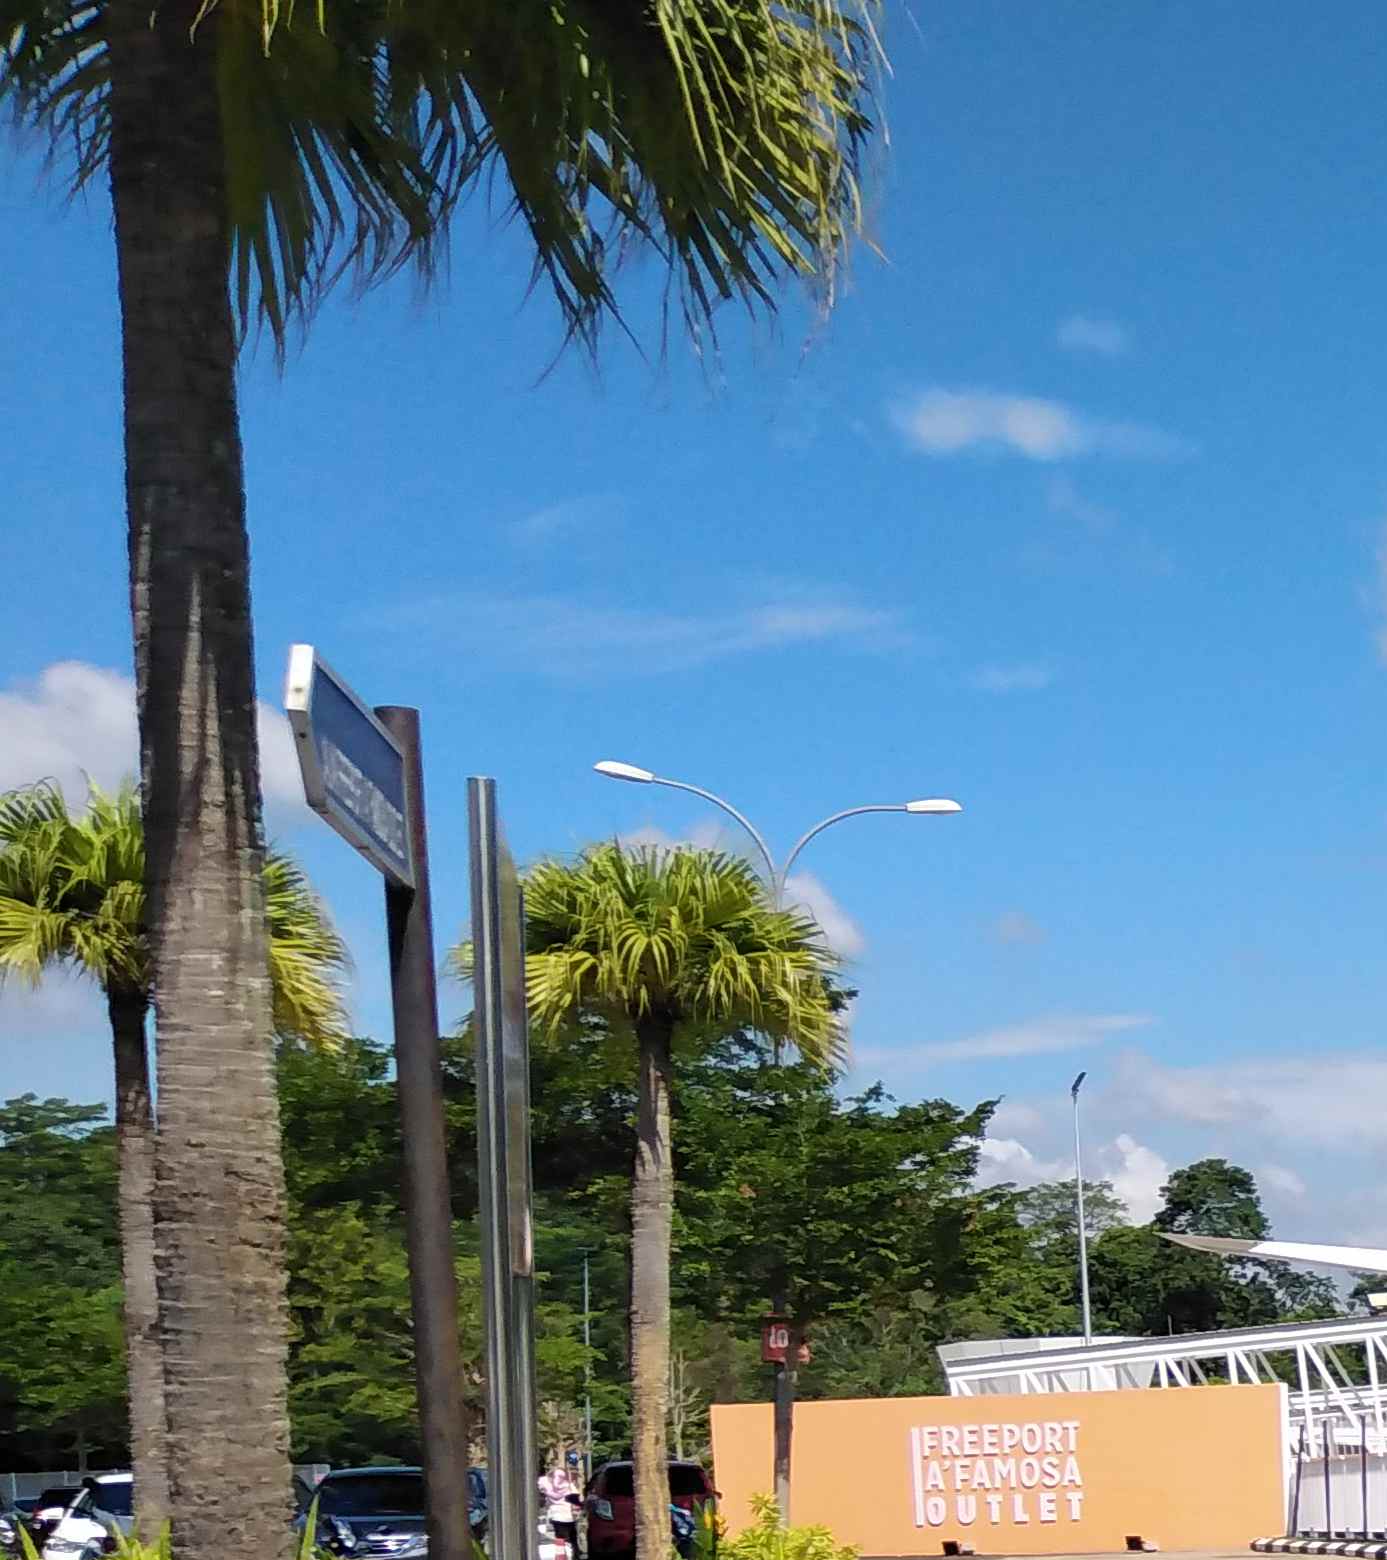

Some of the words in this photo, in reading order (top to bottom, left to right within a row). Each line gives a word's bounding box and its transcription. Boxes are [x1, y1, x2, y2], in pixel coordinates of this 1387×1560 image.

[922, 1420, 1081, 1459] FREEPORT
[925, 1455, 1083, 1492] A'FAMOSA
[926, 1492, 1084, 1526] OUTLET
